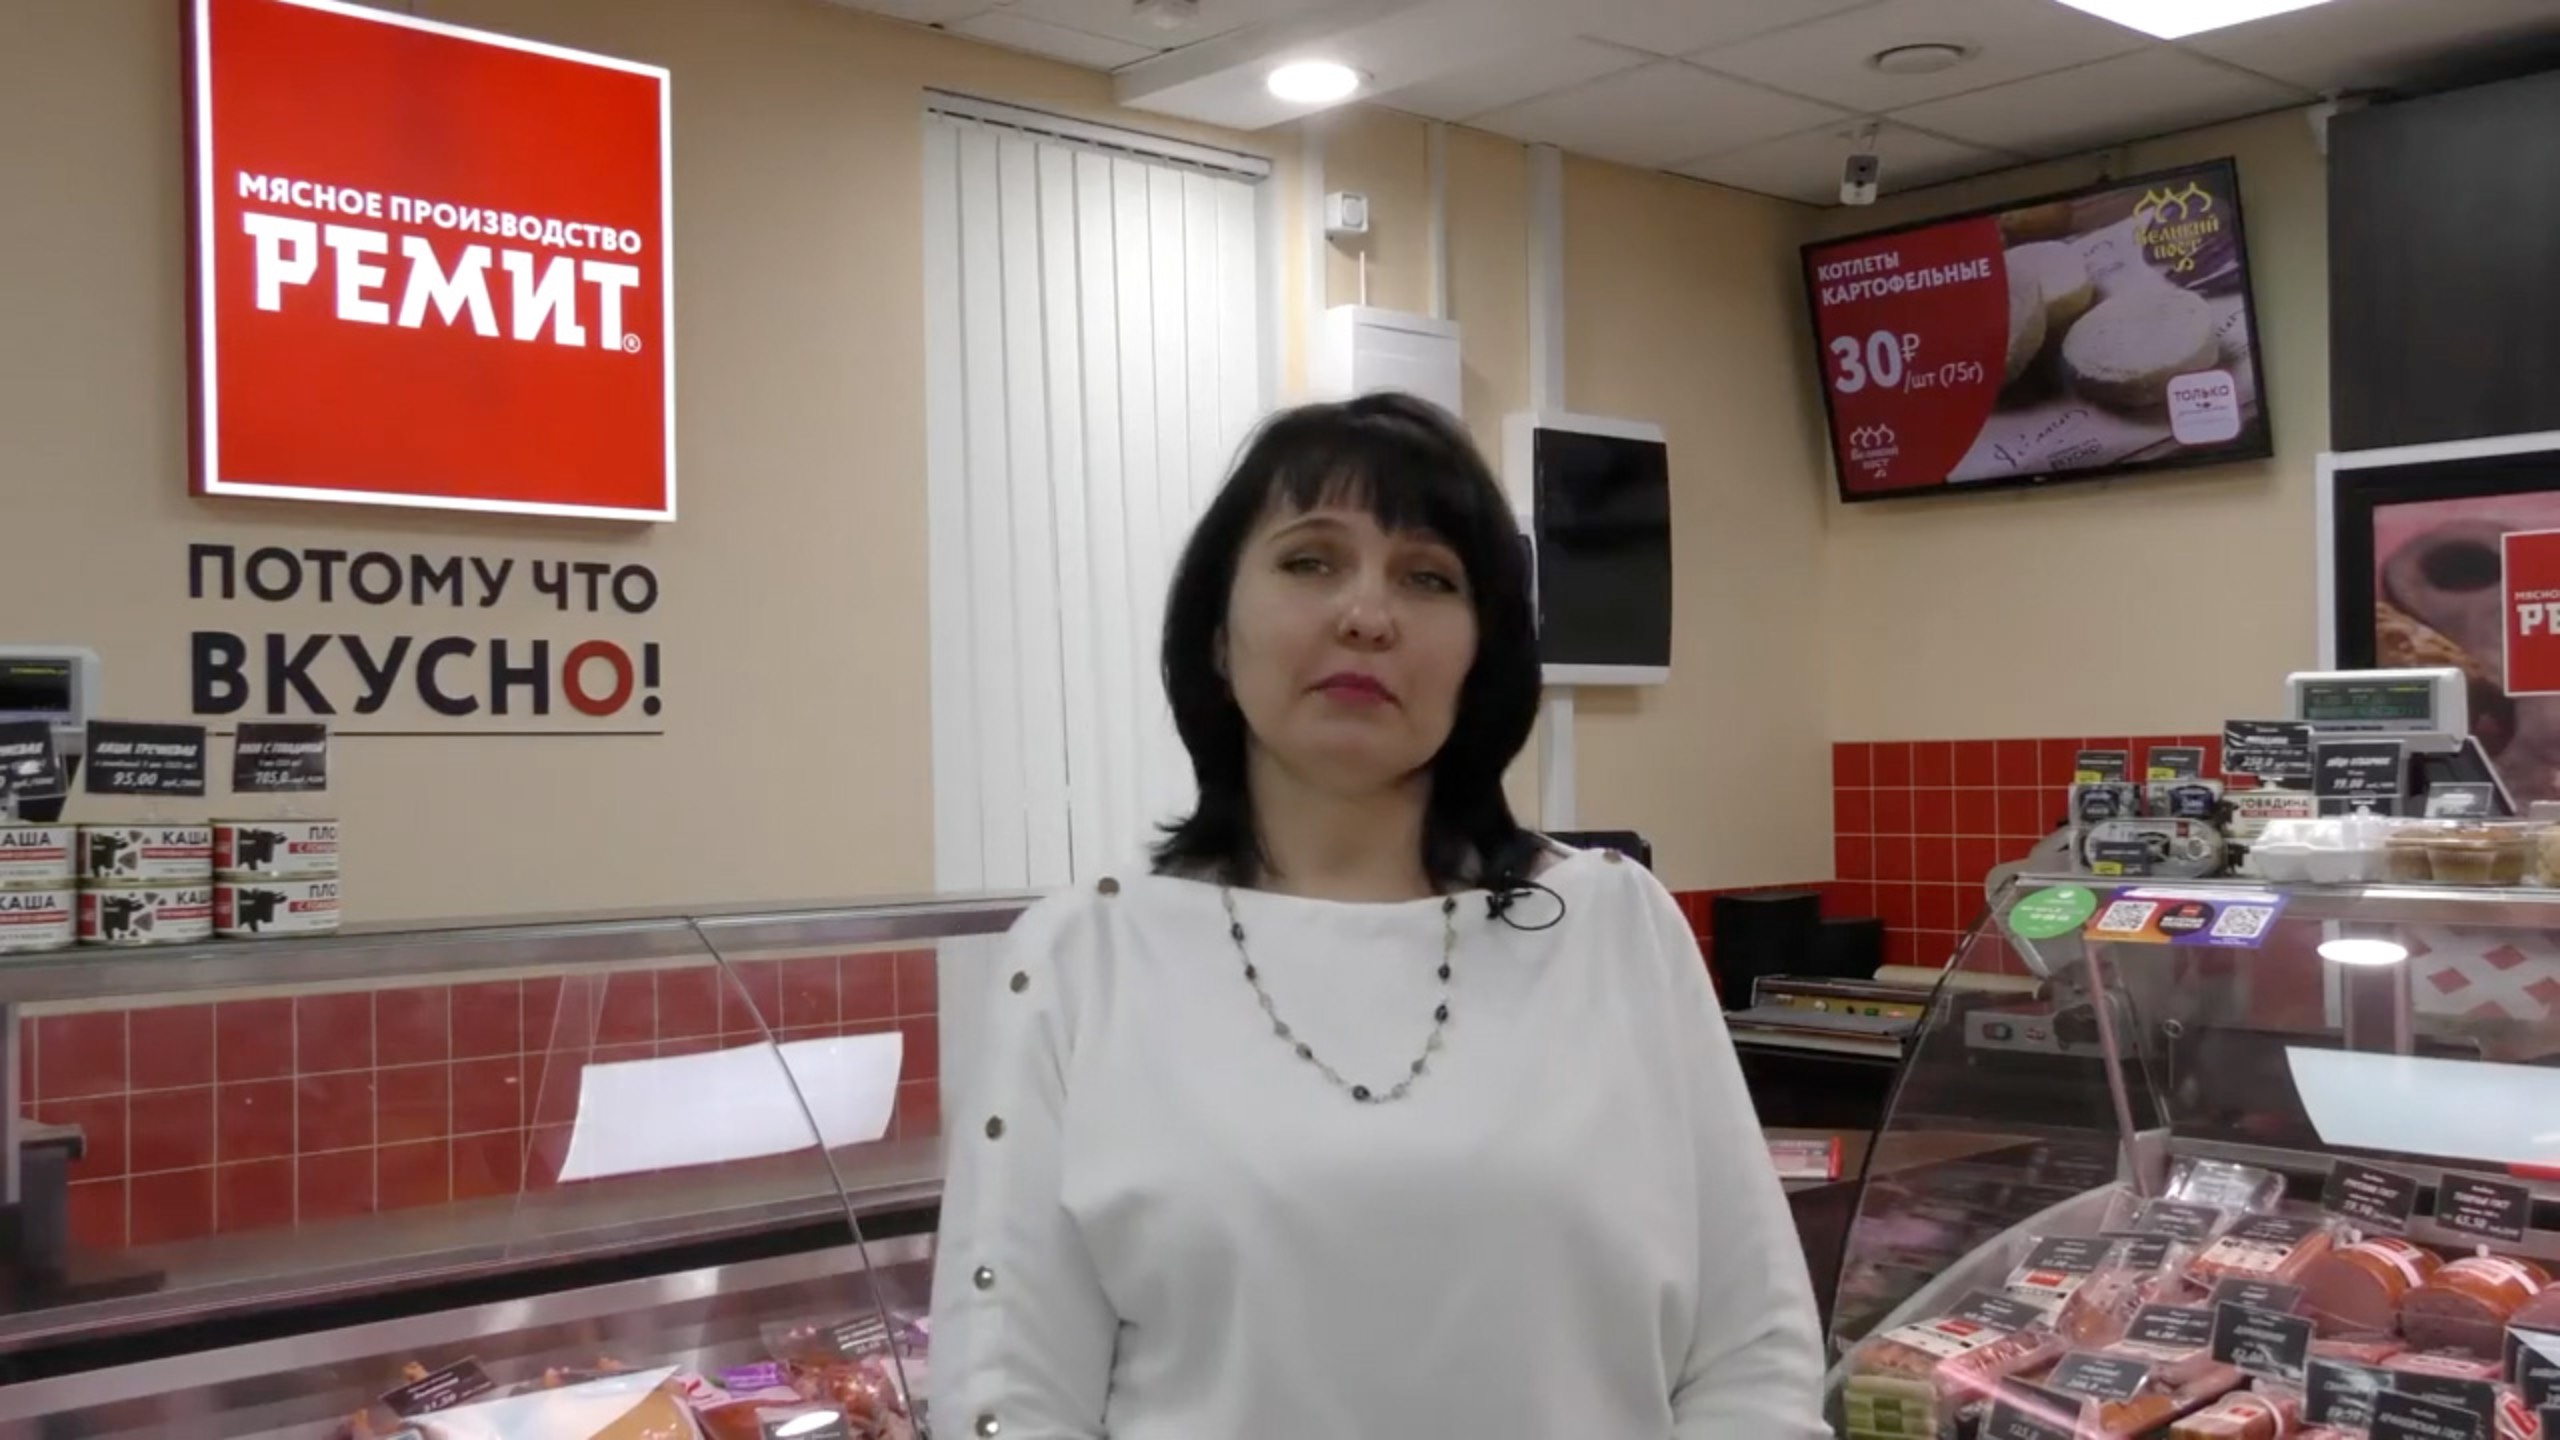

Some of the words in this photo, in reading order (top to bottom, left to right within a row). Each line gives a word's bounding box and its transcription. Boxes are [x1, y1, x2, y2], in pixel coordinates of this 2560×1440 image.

[239, 171, 383, 219] МЯСНОЕ
[390, 196, 642, 255] ПРОИЗВОДСТВО
[1817, 251, 1900, 282] КОТЛЕТЫ
[1822, 258, 1992, 306] КАРТОФЕЛЬНЫЕ
[1939, 361, 1984, 388] (75г)
[2174, 385, 2230, 402] ТОЛЬКО
[188, 543, 515, 608] ПОТОМУ
[532, 560, 659, 614] ЧТО
[2514, 588, 2560, 600] МЯСНО
[190, 631, 663, 717] ВКУСНО!
[0, 831, 53, 847] АША
